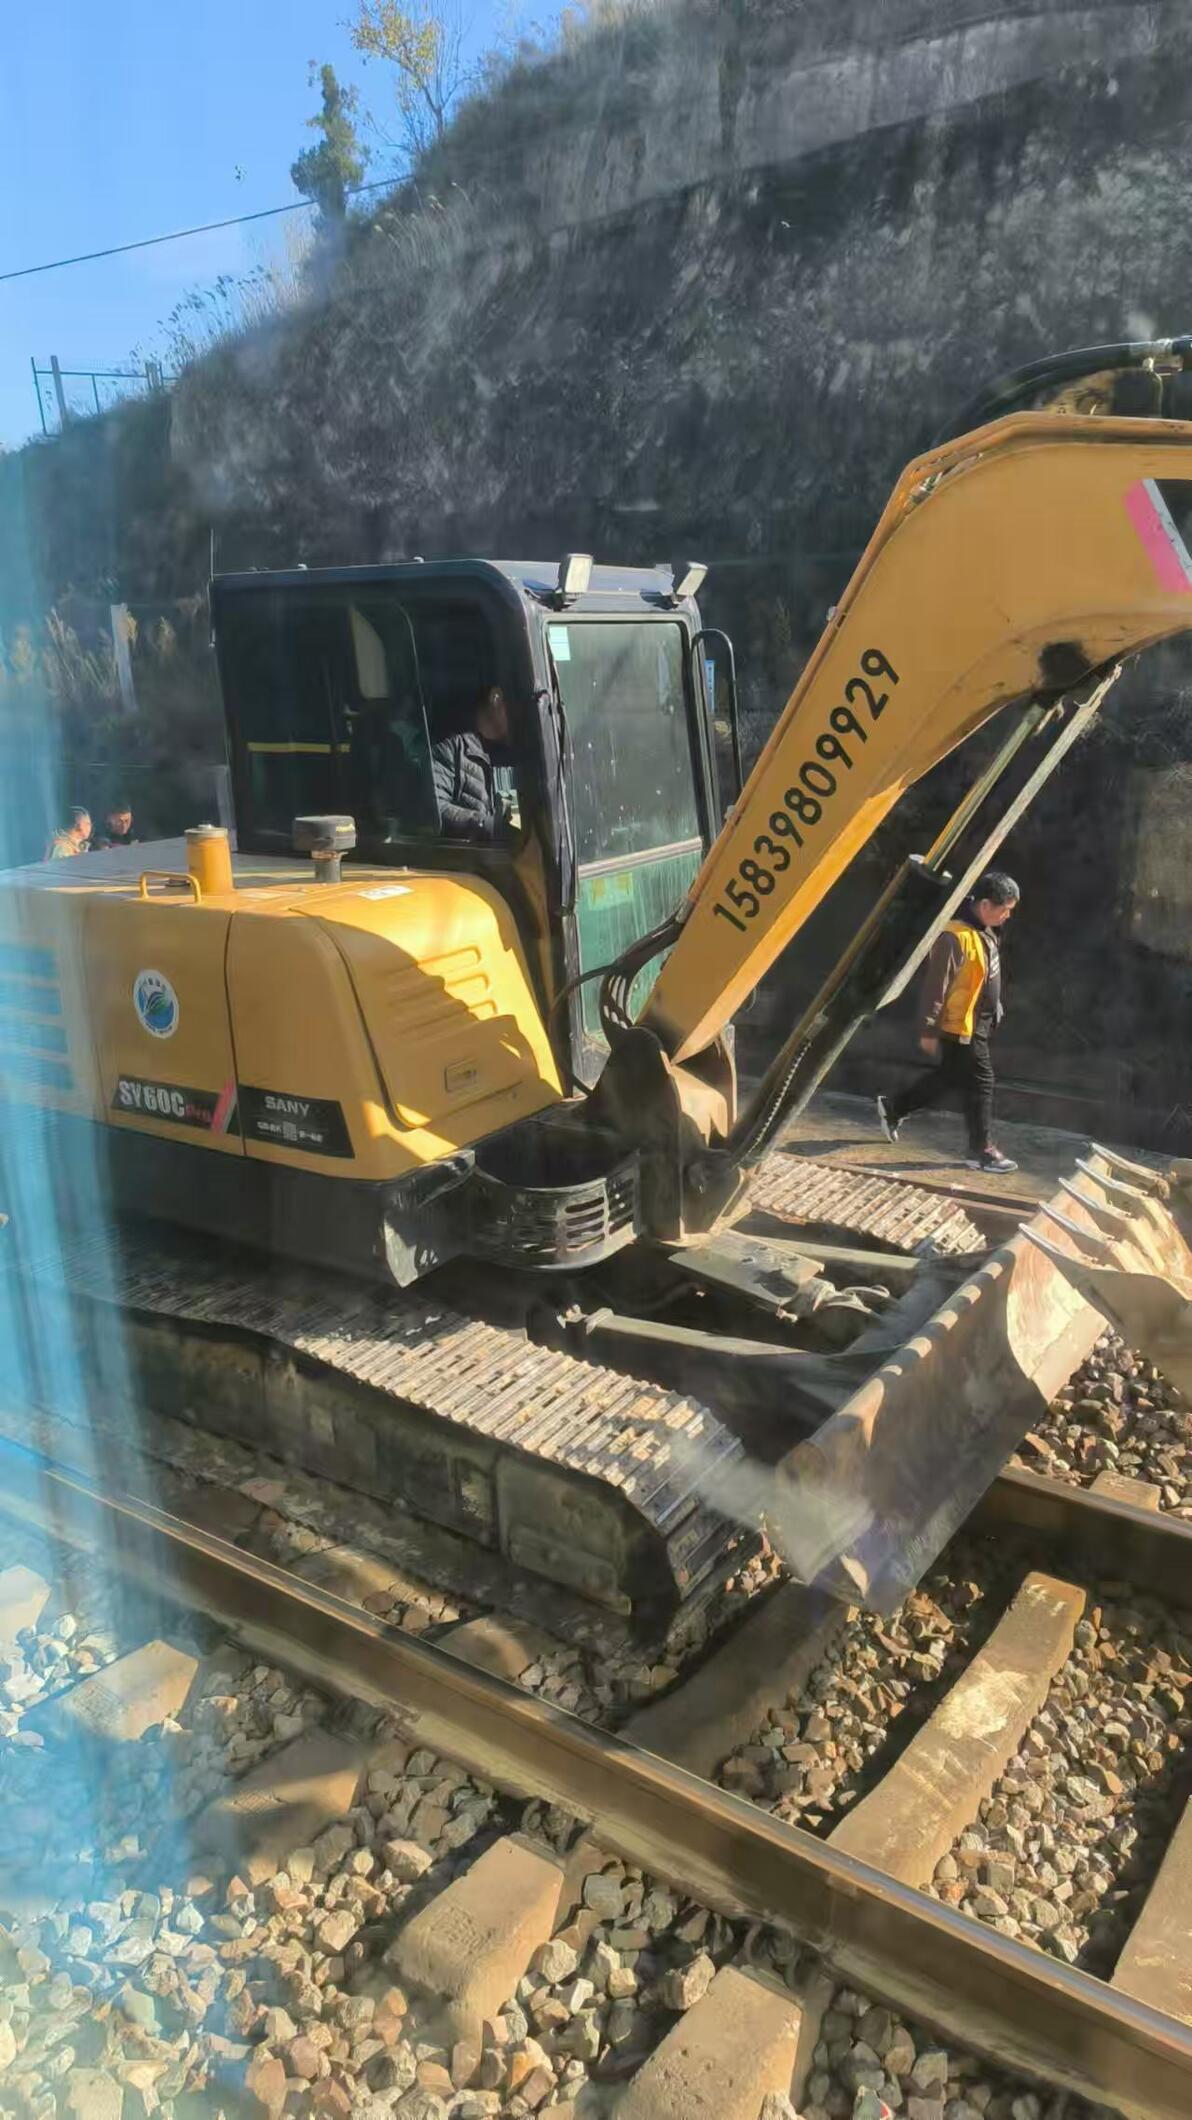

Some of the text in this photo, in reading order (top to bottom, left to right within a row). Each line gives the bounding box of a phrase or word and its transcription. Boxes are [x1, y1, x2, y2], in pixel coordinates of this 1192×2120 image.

[713, 648, 899, 932] 15839809929
[119, 1080, 185, 1118] SY60C
[264, 1095, 310, 1117] SANY
